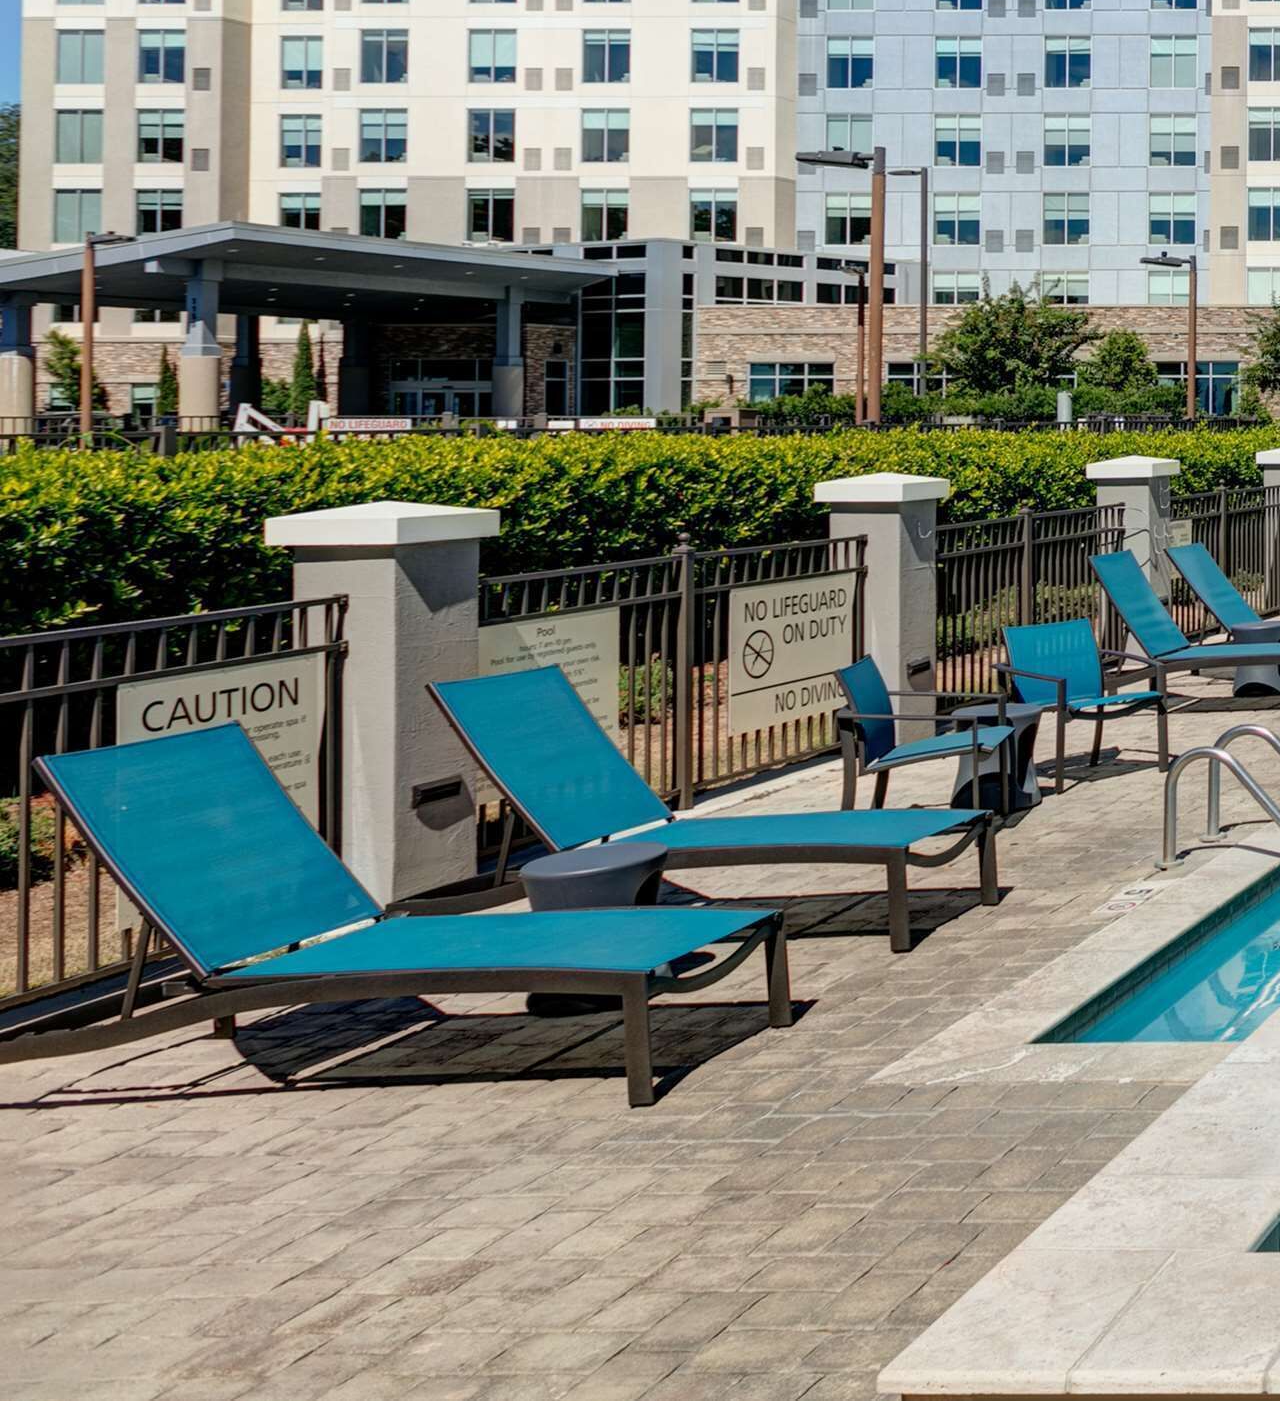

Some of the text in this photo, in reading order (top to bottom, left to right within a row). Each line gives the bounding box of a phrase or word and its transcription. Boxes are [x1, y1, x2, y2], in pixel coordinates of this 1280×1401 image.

[744, 588, 847, 623] NO LIFEGUARD
[536, 625, 556, 638] Pool
[782, 614, 847, 644] ON DUTY
[142, 677, 299, 732] CAUTION
[775, 689, 796, 714] NO
